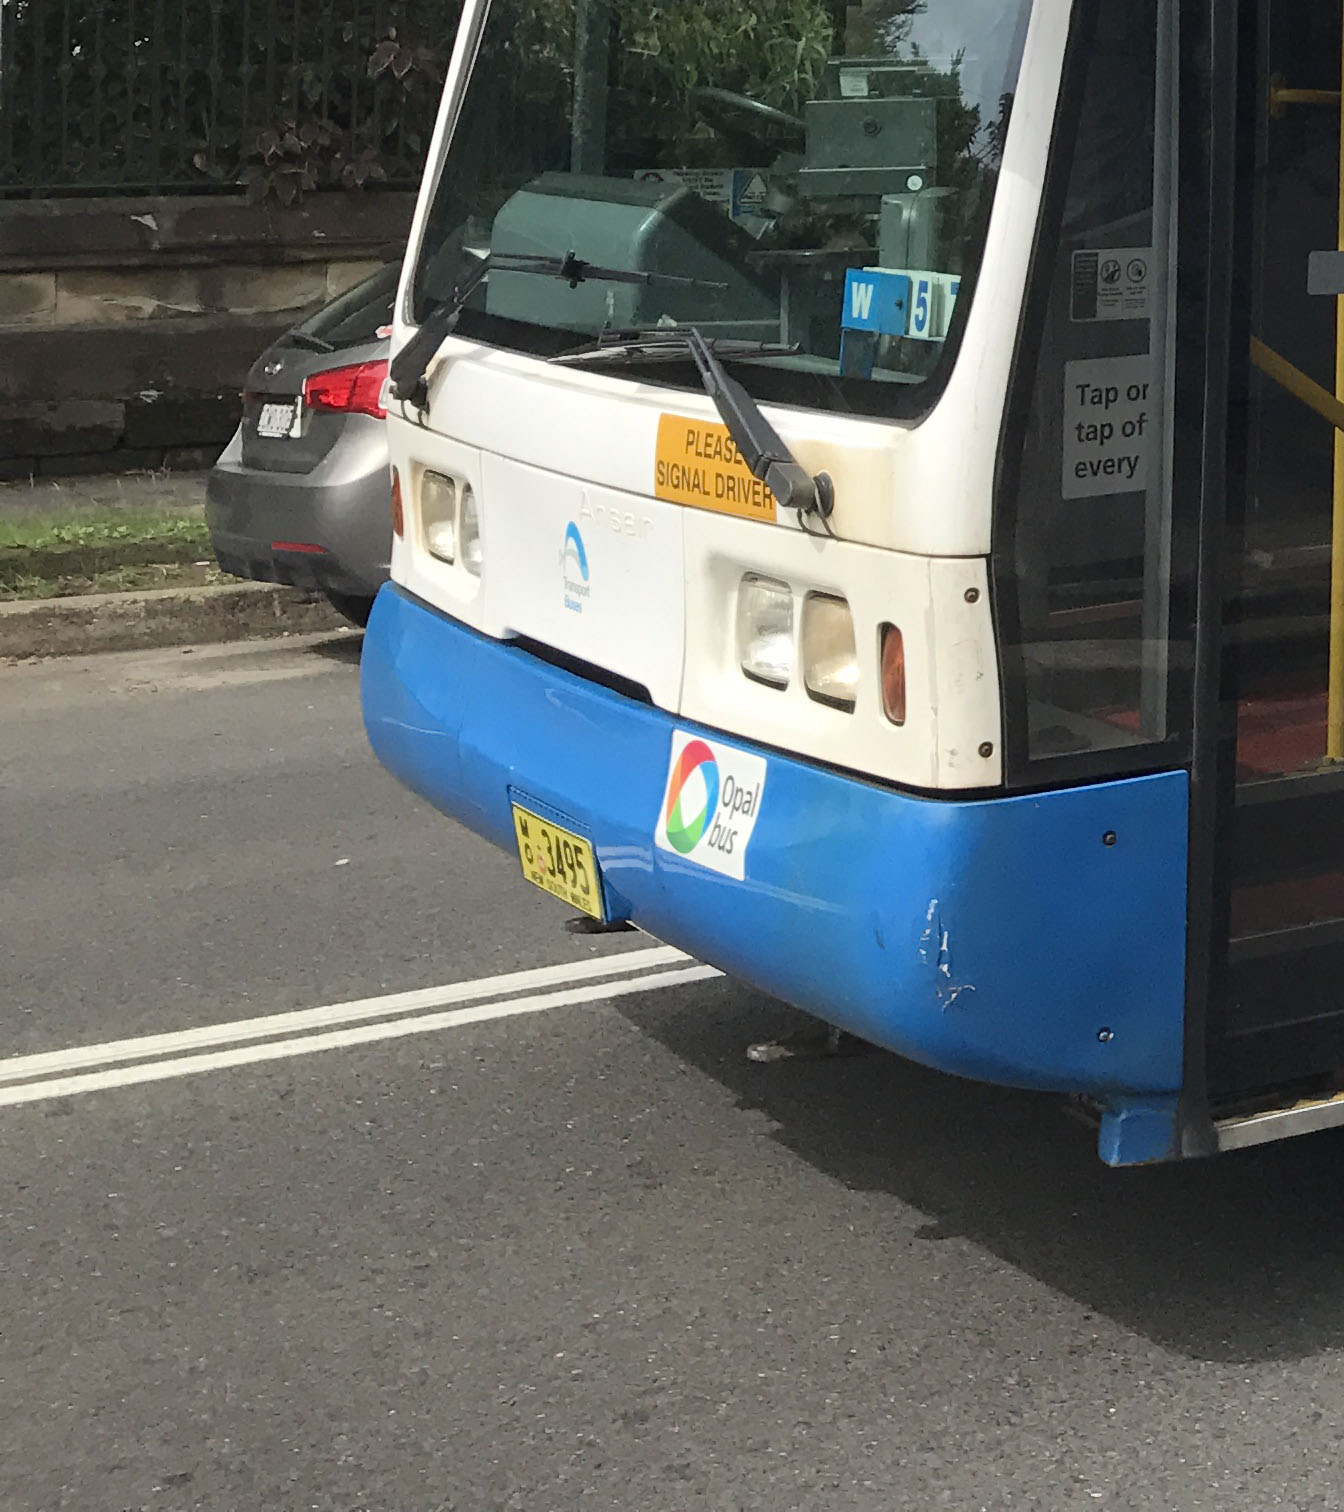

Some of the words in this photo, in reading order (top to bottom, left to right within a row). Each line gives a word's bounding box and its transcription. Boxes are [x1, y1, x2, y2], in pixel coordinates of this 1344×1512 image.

[851, 281, 874, 320] W
[914, 280, 929, 332] 5
[1075, 383, 1119, 410] Tap
[1074, 421, 1114, 446] tap
[656, 459, 711, 496] SIGNAL
[715, 472, 773, 510] DRIVER
[1074, 455, 1139, 479] every
[721, 774, 761, 820] Opal
[707, 811, 738, 855] bus
[541, 829, 590, 896] 3495
